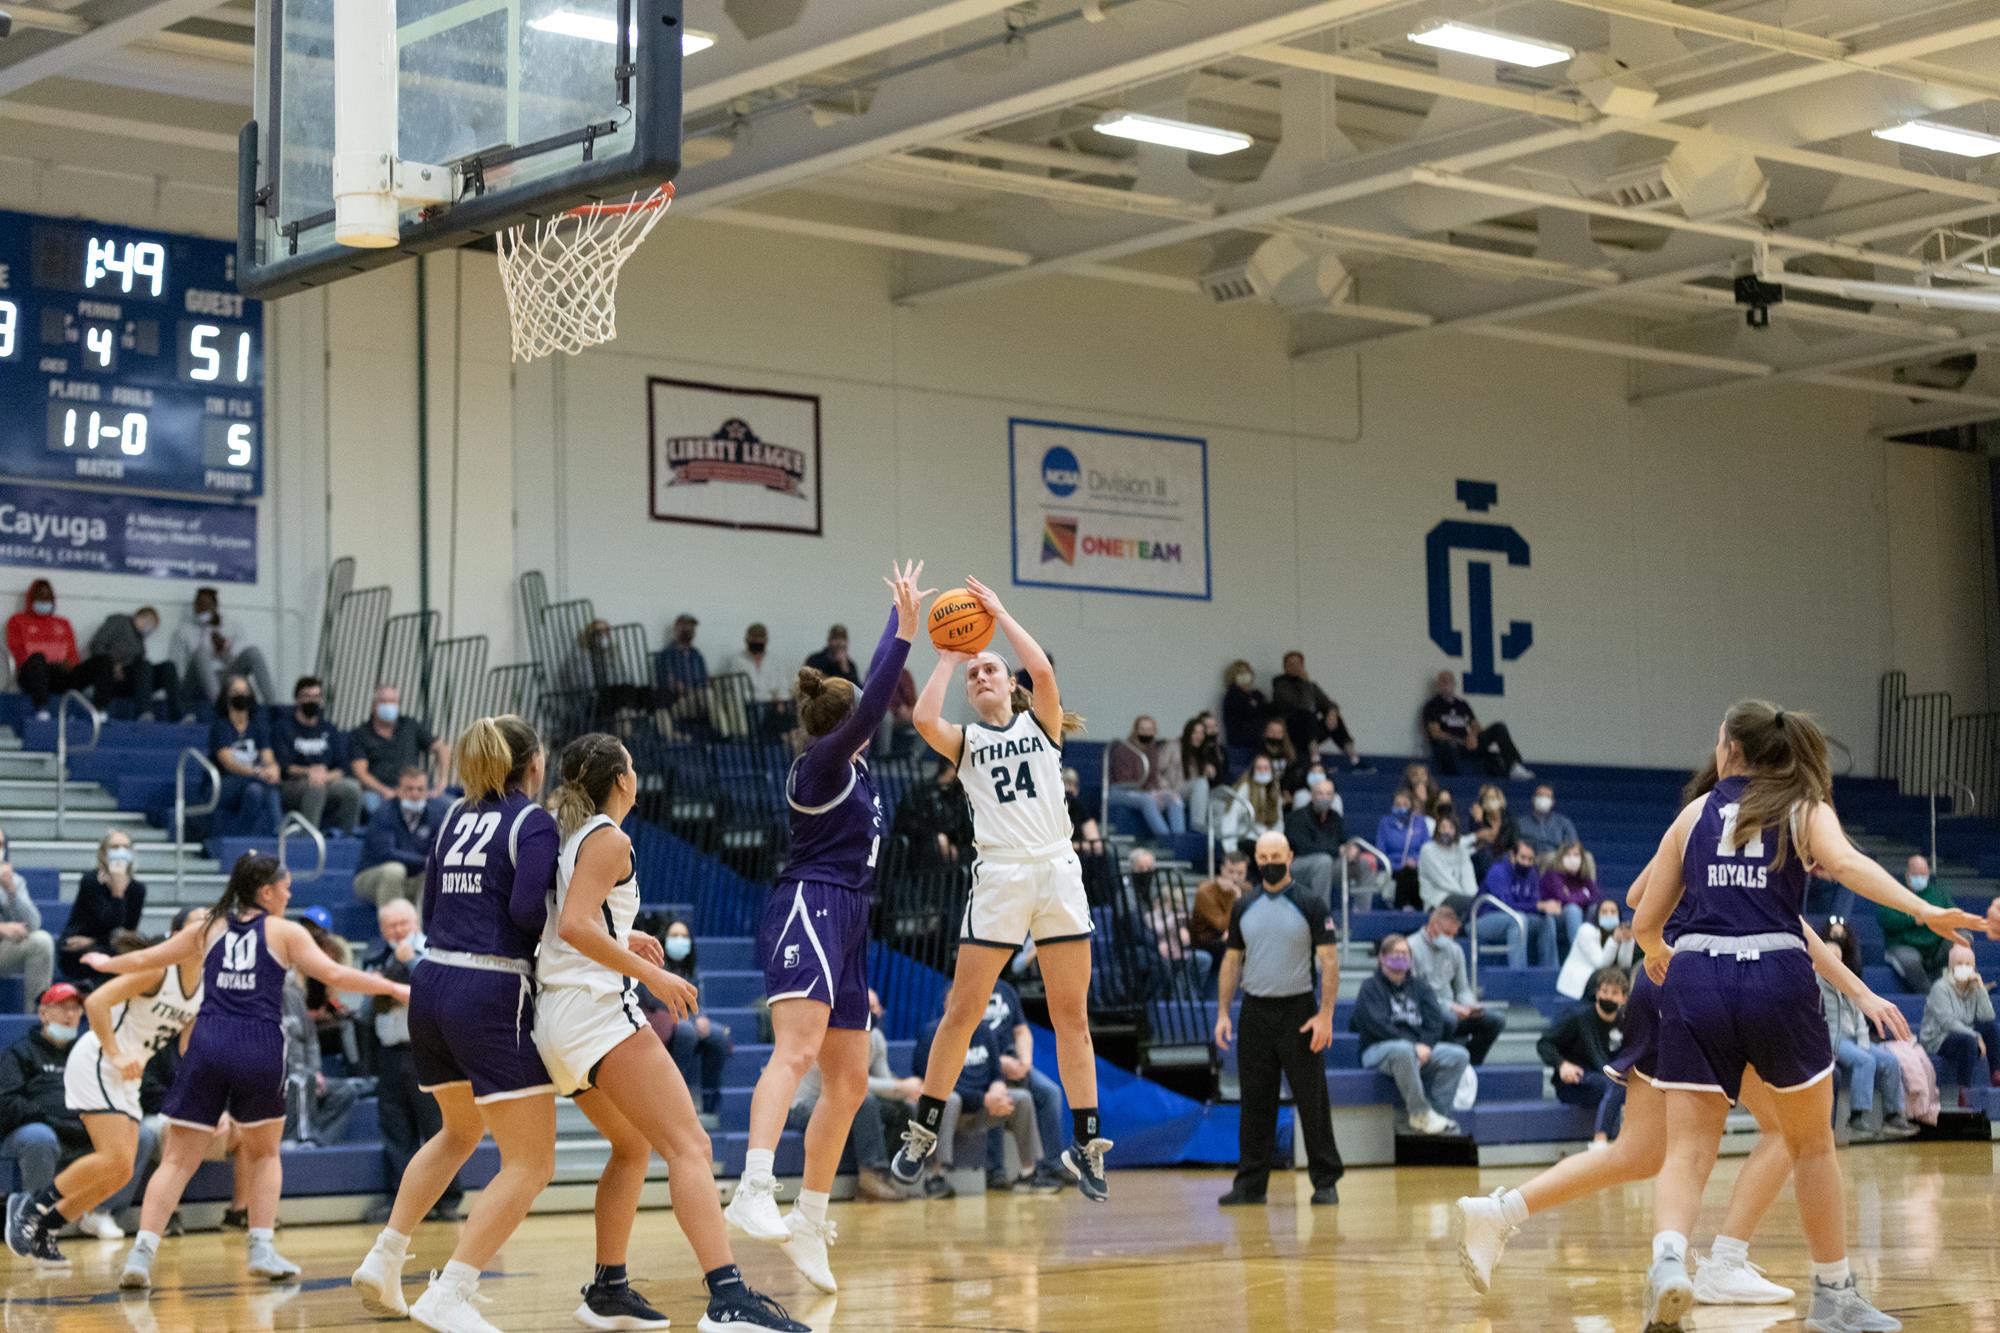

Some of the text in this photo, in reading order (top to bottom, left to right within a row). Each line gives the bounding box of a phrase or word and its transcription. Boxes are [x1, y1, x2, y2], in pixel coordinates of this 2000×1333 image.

[85, 237, 165, 297] 1:49
[185, 288, 244, 318] GUEST
[87, 327, 112, 367] 4
[190, 324, 250, 382] 51
[49, 379, 100, 401] PLAYER
[227, 423, 251, 466] 5
[668, 438, 737, 463] LIBERTY
[741, 440, 805, 476] LEAGUE
[1087, 471, 1151, 494] Division
[0, 504, 107, 546] Cayuga
[1082, 536, 1182, 563] ONETEAM
[934, 602, 976, 621] Wilson
[971, 736, 1044, 768] ITHACA
[992, 761, 1037, 803] 24
[443, 811, 502, 867] 22
[442, 872, 482, 894] ROYALS
[1708, 864, 1768, 888] ROYALS
[222, 929, 257, 971] 10
[216, 972, 256, 990] ROYALS
